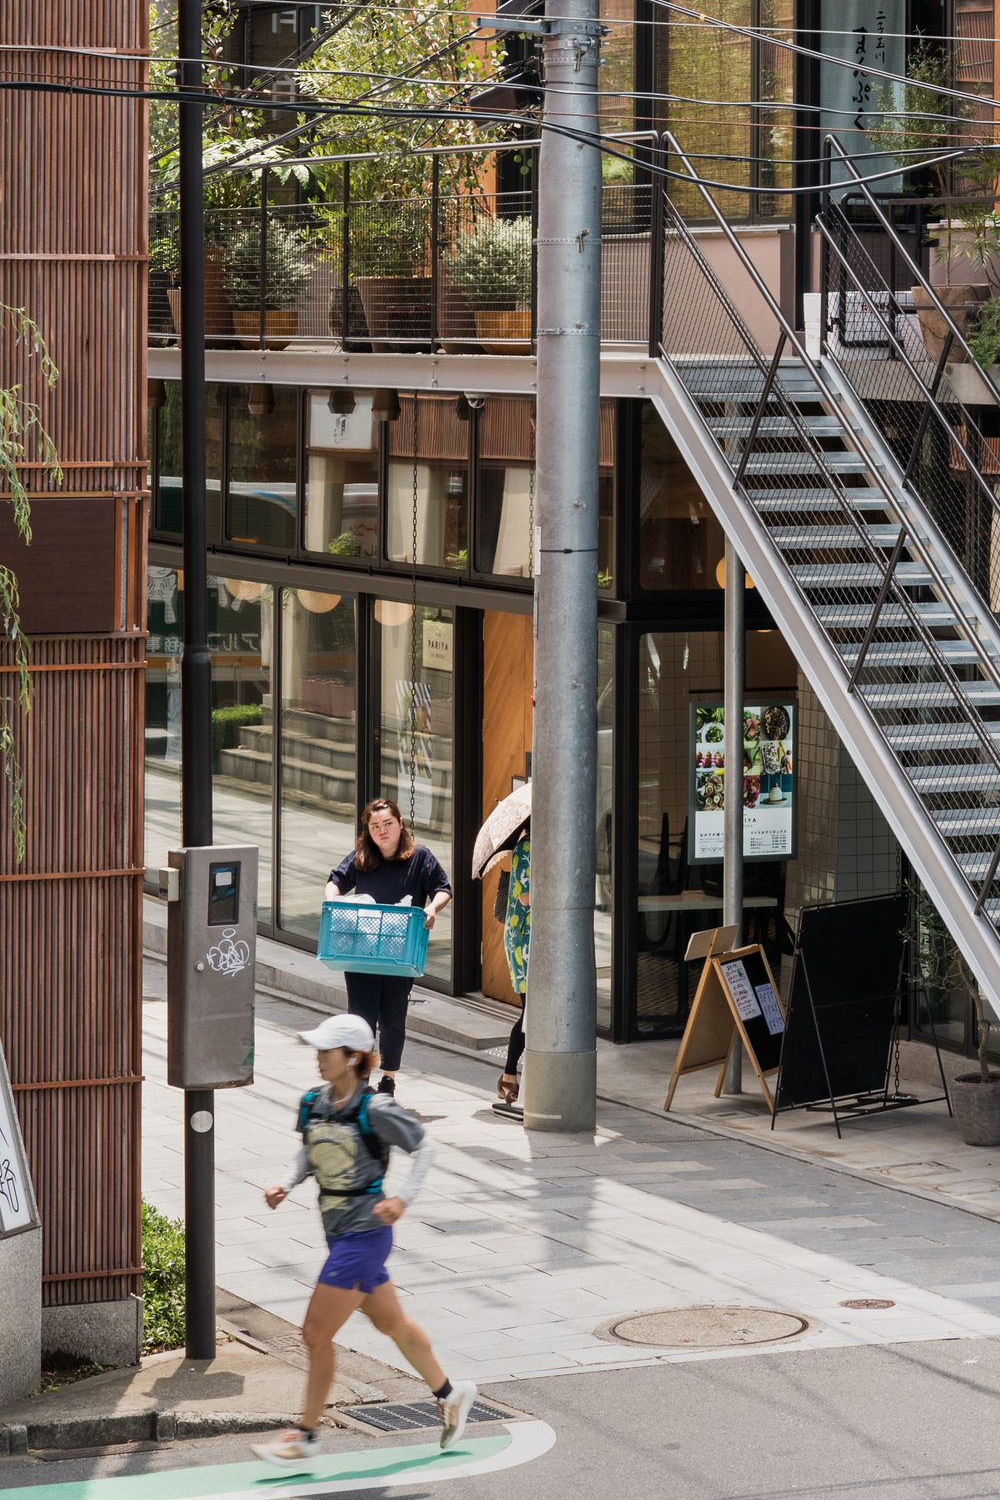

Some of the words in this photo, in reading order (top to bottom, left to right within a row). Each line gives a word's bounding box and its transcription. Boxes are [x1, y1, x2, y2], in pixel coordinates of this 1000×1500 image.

[875, 11, 887, 64] 二子玉川
[852, 26, 871, 131] まんぷく
[427, 639, 449, 652] PARIYA
